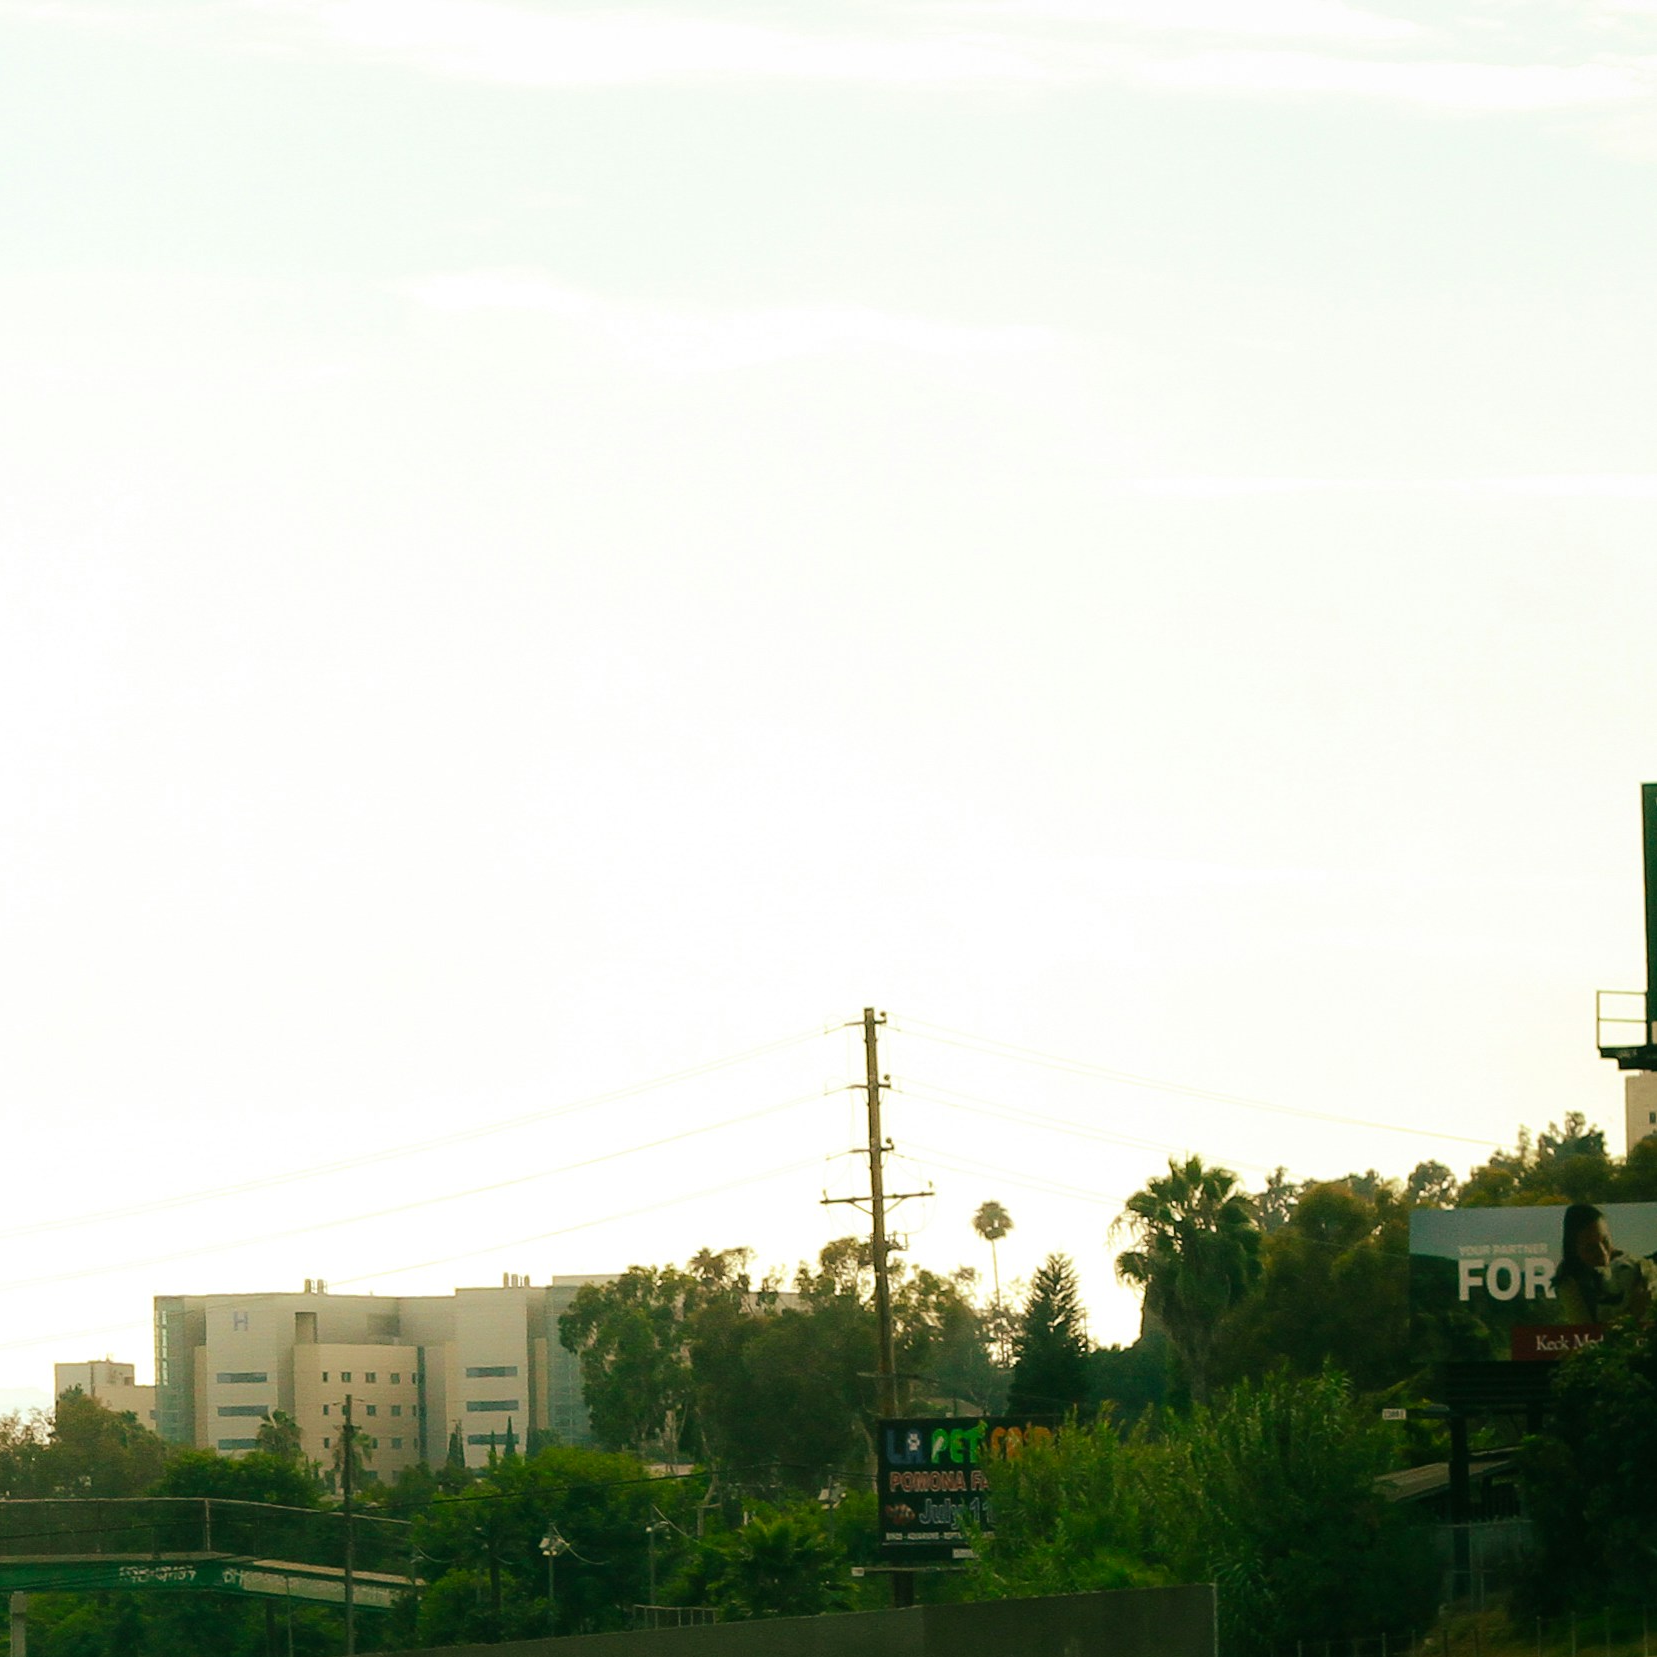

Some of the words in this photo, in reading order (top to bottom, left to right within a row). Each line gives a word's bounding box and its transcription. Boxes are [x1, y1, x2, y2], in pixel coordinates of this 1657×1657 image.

[1493, 1243, 1548, 1254] PARTNER
[1458, 1257, 1557, 1301] FOR
[1537, 1335, 1570, 1351] Keck
[887, 1428, 924, 1465] LA
[931, 1428, 982, 1464] PET
[890, 1471, 966, 1492] POMONA
[919, 1498, 963, 1530] July
